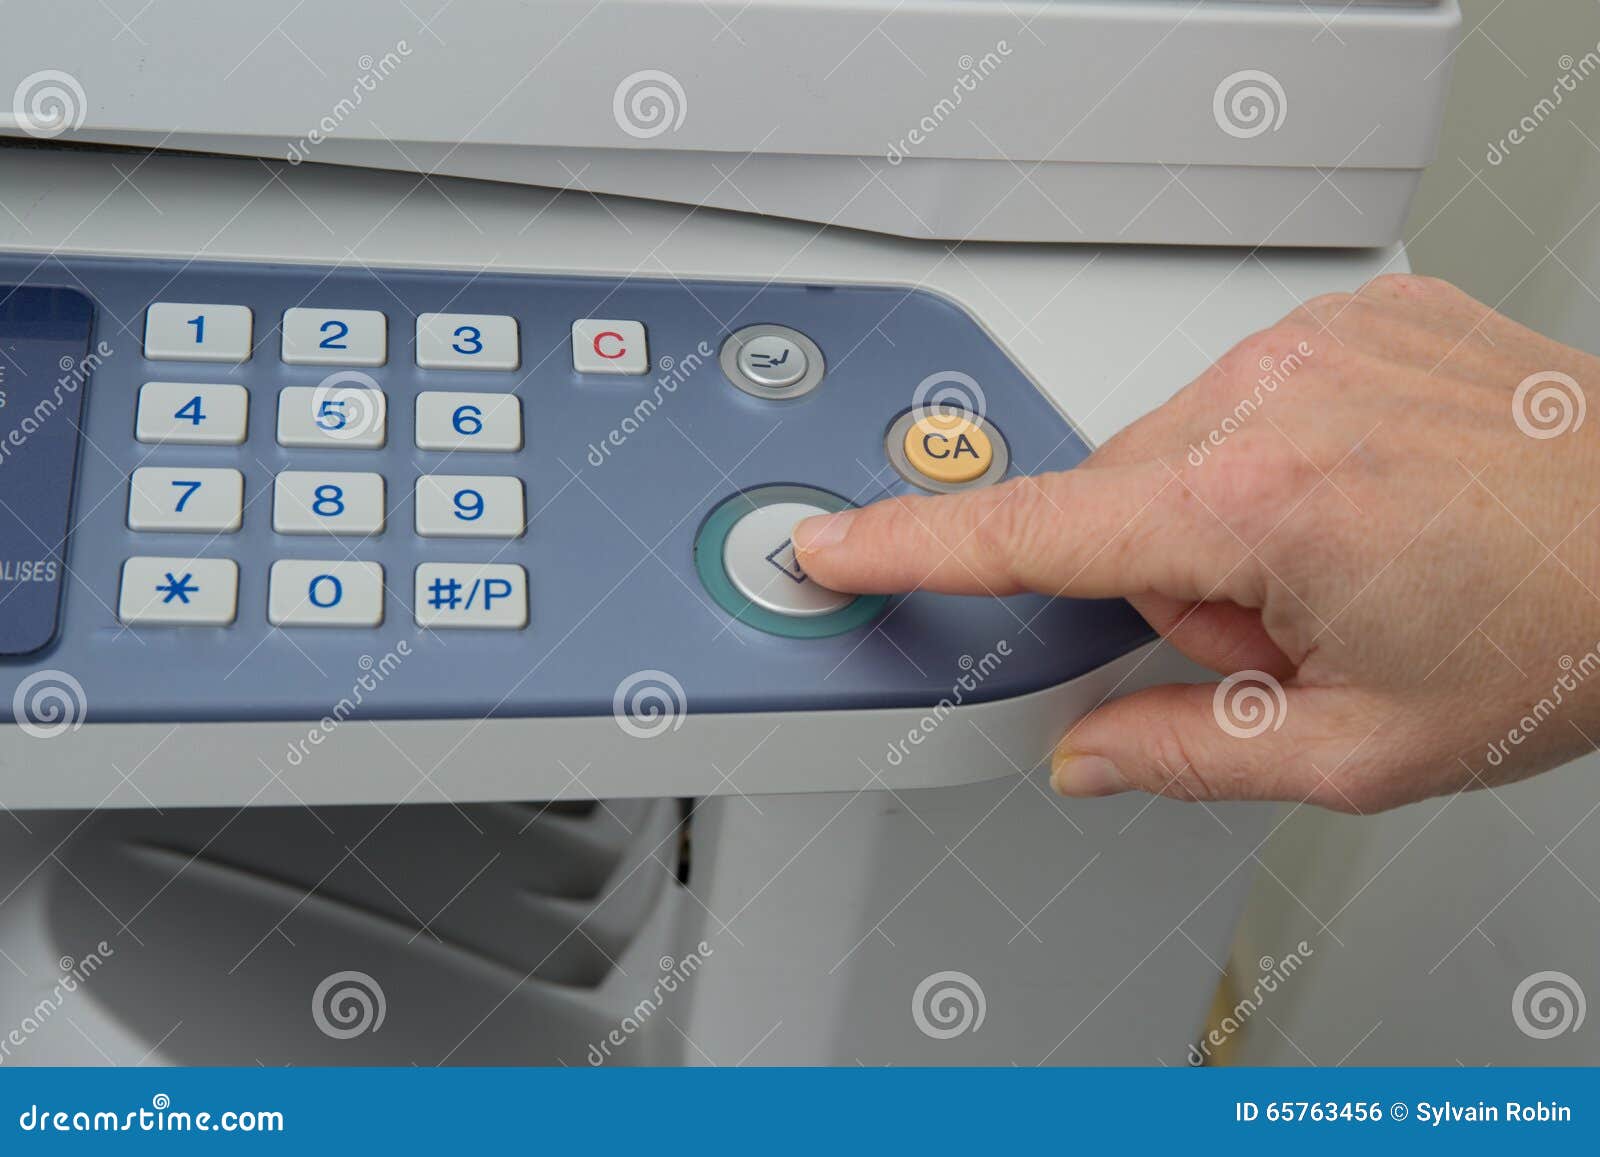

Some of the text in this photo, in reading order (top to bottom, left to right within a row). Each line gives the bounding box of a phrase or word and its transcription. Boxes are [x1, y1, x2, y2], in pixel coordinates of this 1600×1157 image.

[187, 315, 205, 345] 1
[319, 320, 350, 350] 2
[452, 326, 484, 355] 3
[593, 331, 627, 360] C
[174, 395, 206, 427] 4
[315, 400, 347, 431] 5
[452, 405, 484, 436] 6
[923, 433, 980, 460] CA
[171, 480, 202, 513] 7
[312, 484, 346, 517] 8
[453, 489, 485, 522] 9
[428, 578, 513, 611] #/P
